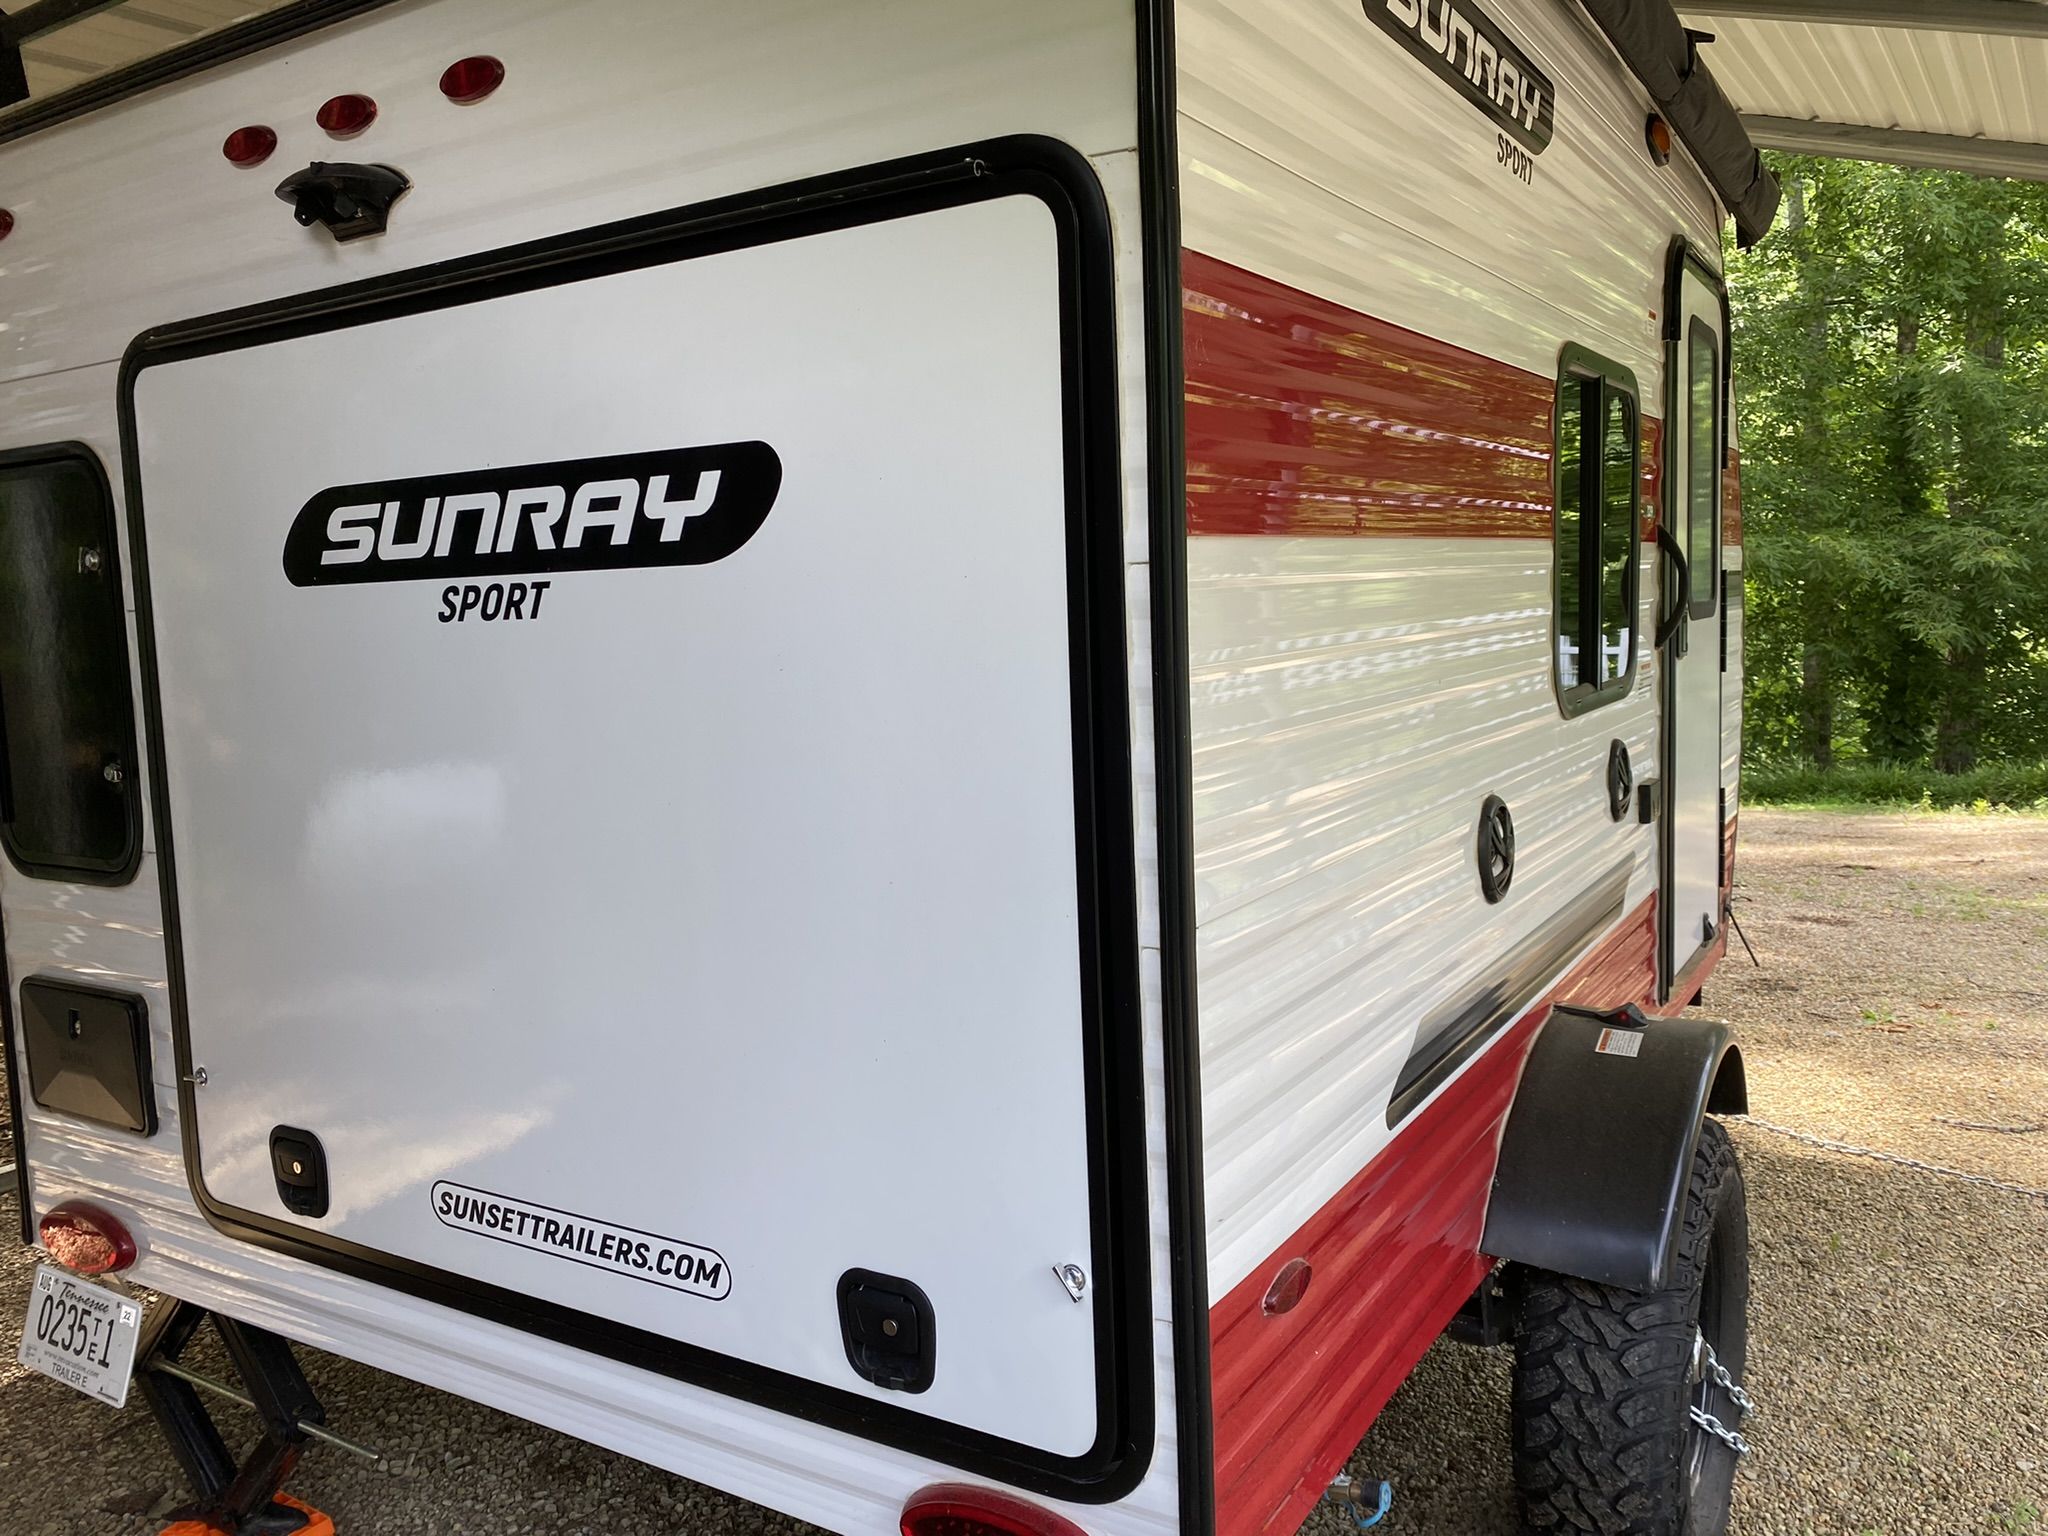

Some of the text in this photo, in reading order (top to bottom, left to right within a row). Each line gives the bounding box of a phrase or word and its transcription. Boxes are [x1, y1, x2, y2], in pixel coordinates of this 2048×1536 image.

[1496, 133, 1533, 186] SPORT
[320, 469, 722, 566] SUNRAY
[438, 581, 551, 623] SPORT
[438, 1191, 722, 1289] SUNSETTRAILERS.COM
[60, 1282, 110, 1313] Tennessee
[51, 1362, 82, 1385] TRAILER
